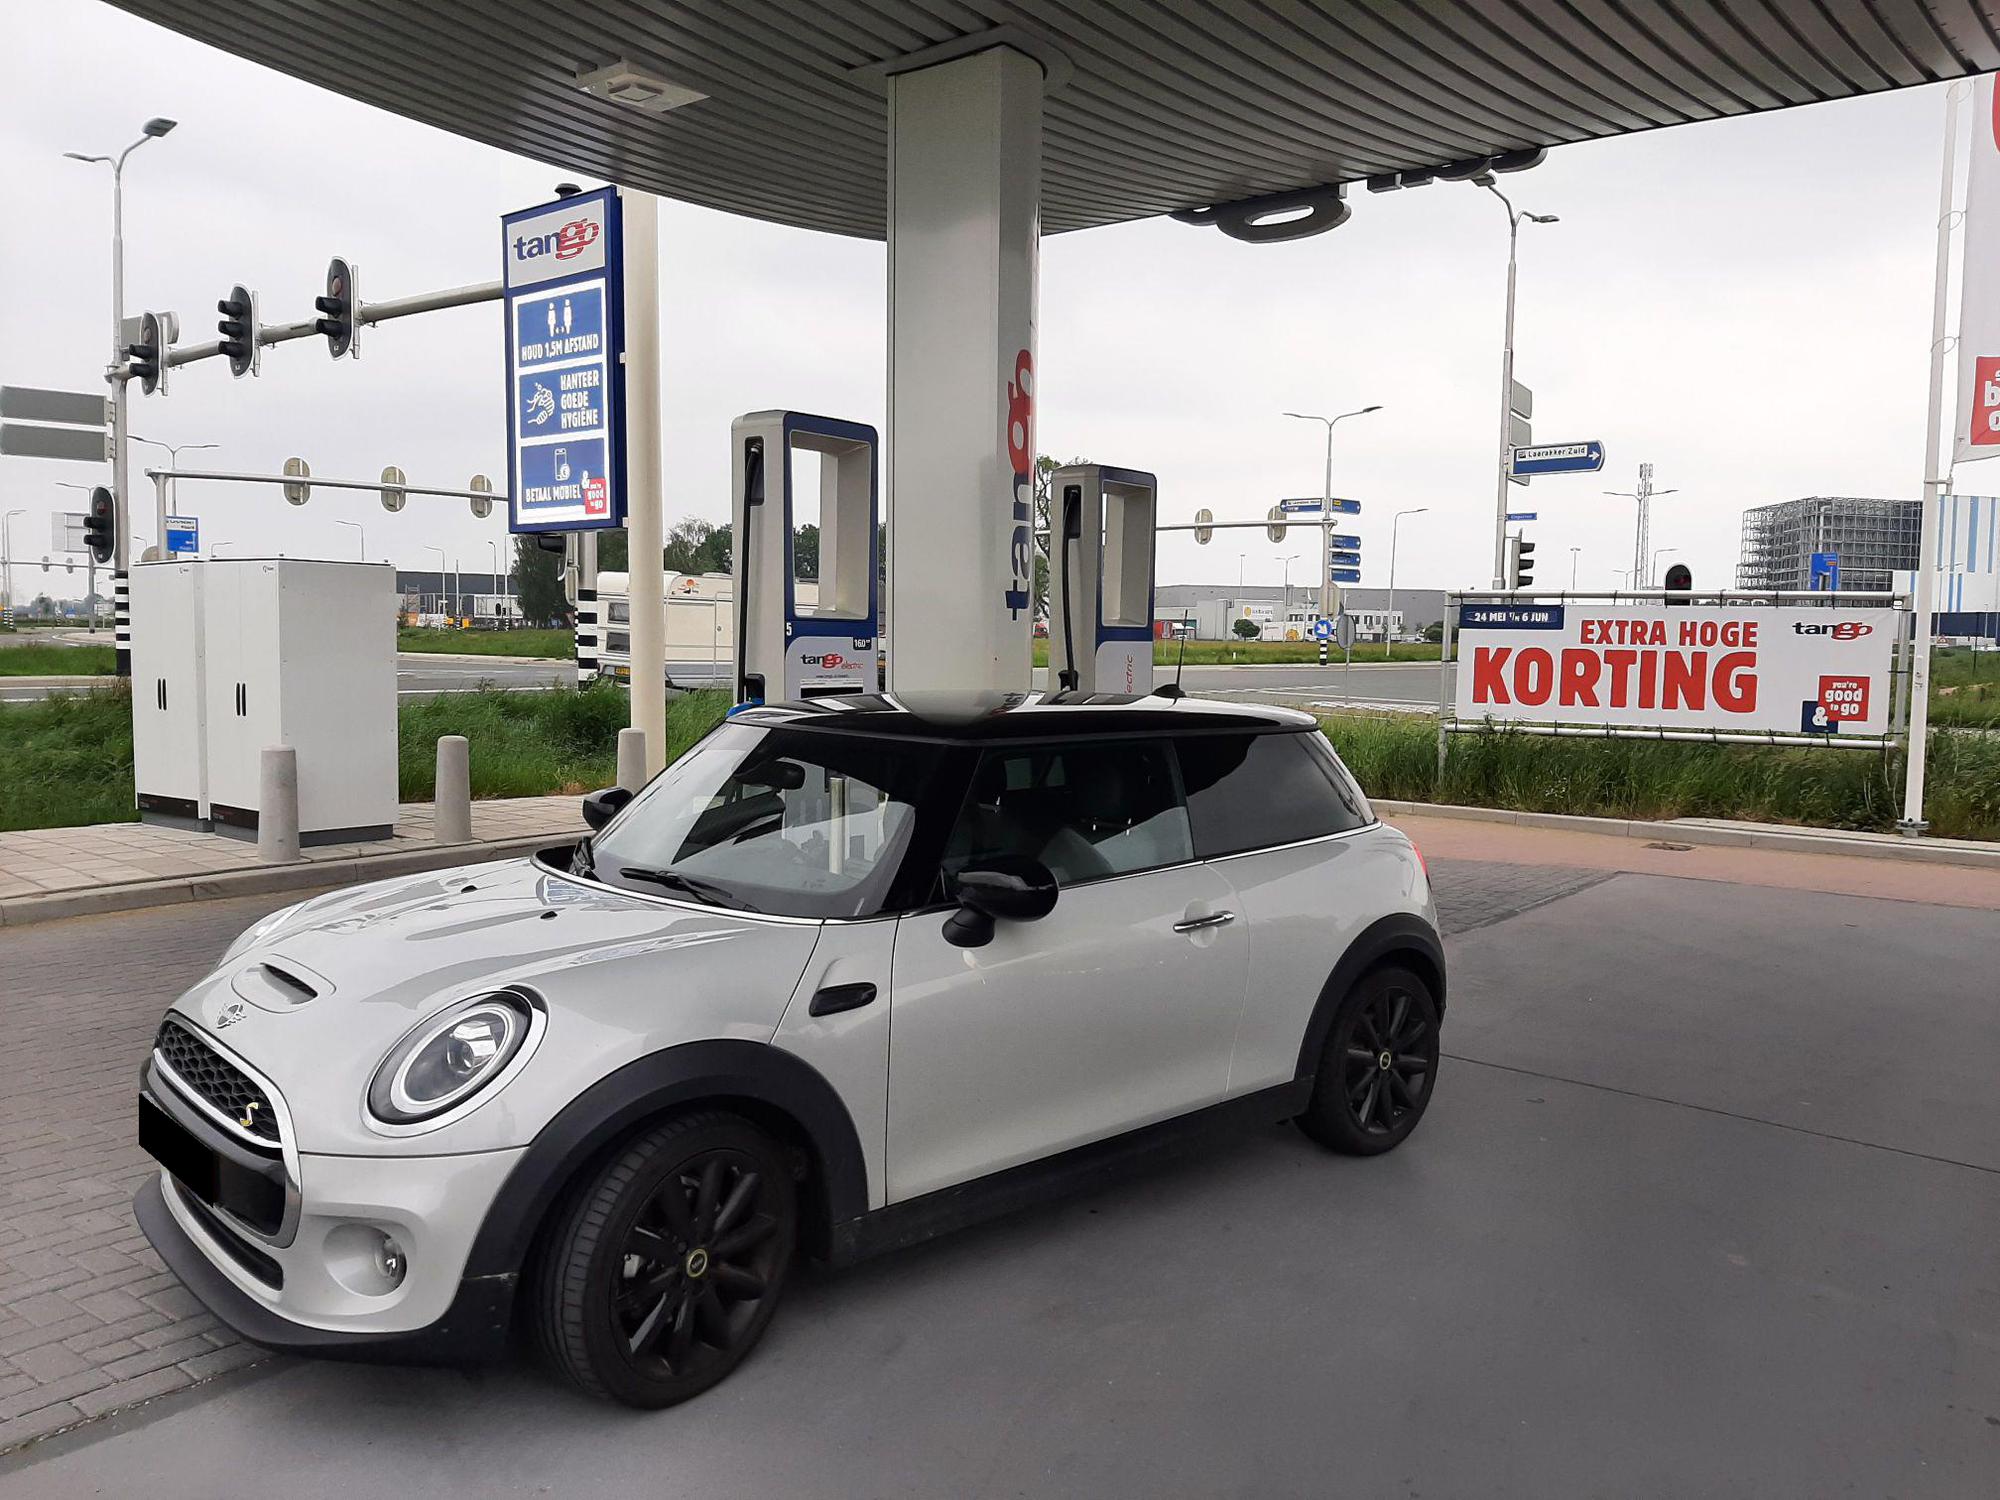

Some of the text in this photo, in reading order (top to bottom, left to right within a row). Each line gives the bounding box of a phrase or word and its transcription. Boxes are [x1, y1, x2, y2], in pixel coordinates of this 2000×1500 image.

[513, 218, 600, 260] tango
[521, 333, 599, 361] HOUD 1,5M AFSTAND
[560, 370, 599, 391] HANTEER
[561, 391, 589, 410] GOEDE
[1528, 446, 1586, 458] Laarakker Zuid
[525, 484, 581, 503] BETAAL MOBIEL
[1005, 349, 1036, 621] tango
[1474, 612, 1487, 622] 24
[1489, 612, 1506, 622] MEI
[1522, 612, 1529, 622] 6
[1530, 612, 1549, 623] JUN
[785, 622, 793, 636] 5
[1580, 619, 1759, 648] EXTRA HOGE
[1792, 621, 1873, 641] tango
[801, 653, 843, 669] tango
[1472, 647, 1758, 713] KORTING
[1831, 681, 1858, 689] you're
[1825, 688, 1863, 703] good
[1812, 706, 1828, 726] &
[1830, 702, 1860, 716] to go
